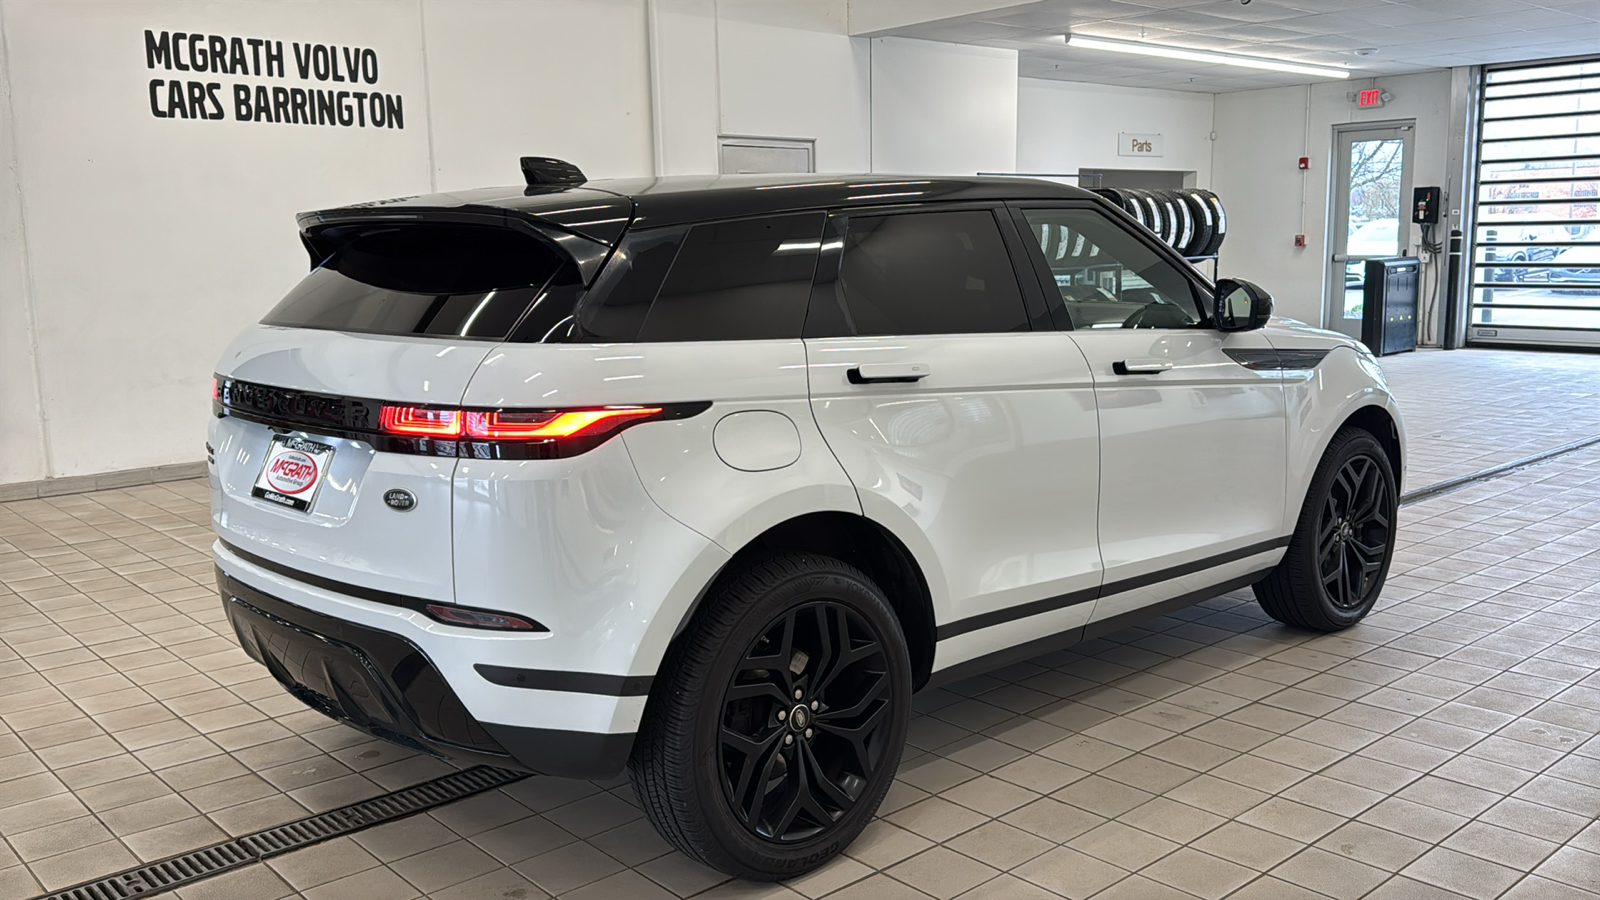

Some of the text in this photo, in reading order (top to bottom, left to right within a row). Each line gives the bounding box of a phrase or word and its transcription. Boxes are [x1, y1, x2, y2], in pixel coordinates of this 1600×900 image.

[144, 30, 378, 84] MCGRATH VOLVO
[149, 79, 404, 130] CARS BARRINGTON
[1359, 89, 1379, 106] EXIT
[1132, 138, 1152, 153] Parts
